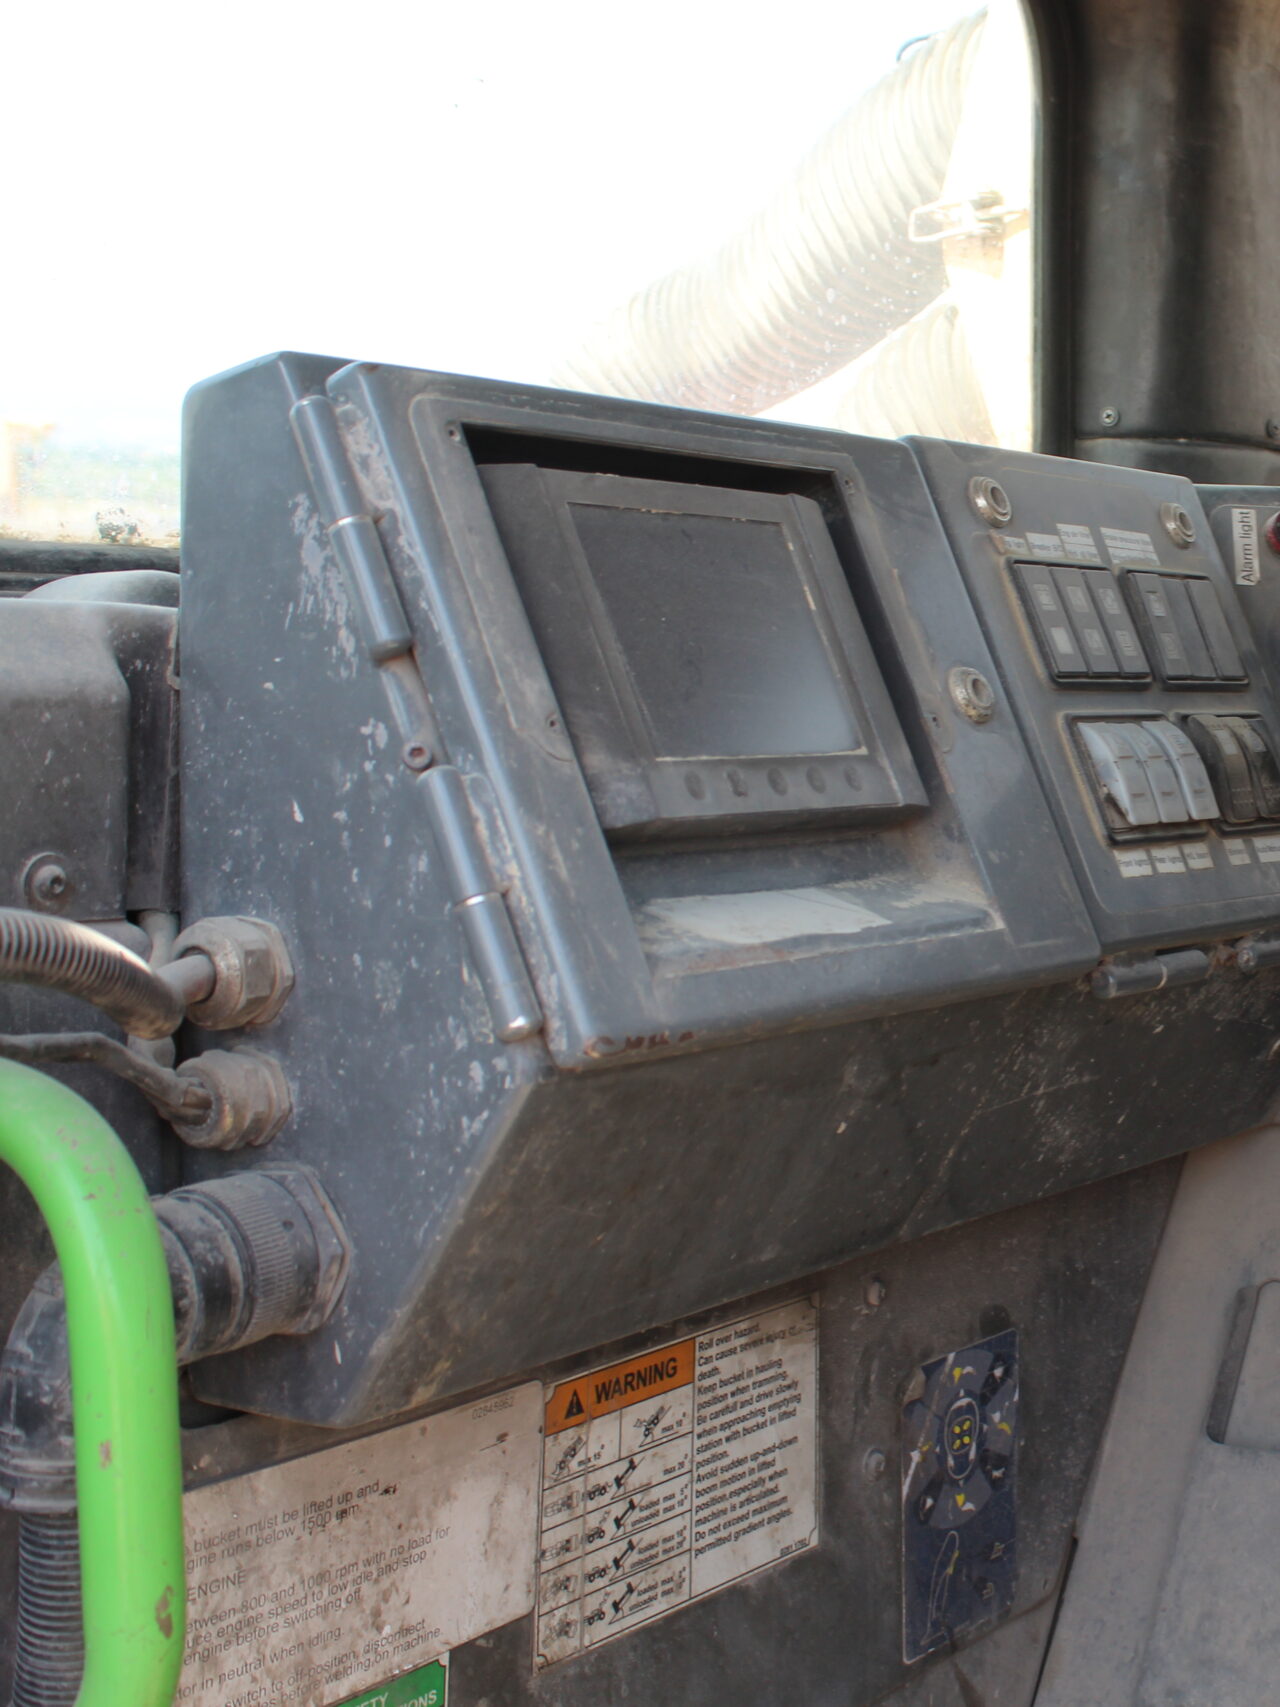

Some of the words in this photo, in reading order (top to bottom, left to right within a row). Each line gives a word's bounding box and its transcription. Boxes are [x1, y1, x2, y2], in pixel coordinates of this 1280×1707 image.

[1240, 511, 1251, 538] light
[1241, 541, 1255, 583] Alarm
[698, 1338, 714, 1353] Roll
[715, 1334, 732, 1347] over
[698, 1355, 714, 1367] Can
[715, 1346, 738, 1361] cause
[594, 1357, 678, 1404] WARNING
[696, 1392, 728, 1414] position
[730, 1384, 750, 1398] when
[697, 1382, 718, 1396] Keep
[718, 1370, 745, 1388] bucket
[746, 1369, 754, 1378] in
[755, 1358, 782, 1374] hauling
[696, 1414, 708, 1426] Be
[739, 1395, 754, 1409] and
[755, 1389, 774, 1403] drive
[776, 1380, 799, 1396] slowly
[696, 1426, 718, 1440] when
[719, 1407, 766, 1432] approaching
[768, 1392, 801, 1412] emptying
[696, 1438, 723, 1455] station
[724, 1430, 741, 1444] with
[742, 1418, 768, 1437] bucket
[770, 1416, 776, 1426] in
[778, 1406, 797, 1422] lifted
[696, 1466, 718, 1484] Avoid
[720, 1456, 748, 1474] sudden
[696, 1483, 718, 1498] boom
[720, 1472, 746, 1489] motion
[748, 1467, 756, 1476] in
[757, 1456, 776, 1472] lifted
[768, 1467, 788, 1482] when
[194, 1526, 241, 1552] bucket
[245, 1514, 278, 1535] must
[282, 1508, 299, 1524] be
[303, 1494, 333, 1517] lifted
[336, 1491, 352, 1507] up
[356, 1480, 380, 1499] and
[694, 1530, 706, 1542] Do
[708, 1522, 722, 1536] not
[722, 1510, 750, 1530] exceed
[752, 1496, 788, 1518] maximum
[695, 1506, 728, 1528] machine
[730, 1502, 736, 1512] is
[186, 1552, 216, 1574] gine
[221, 1540, 251, 1560] runs
[255, 1525, 296, 1548] below
[300, 1511, 332, 1532] 1500
[694, 1531, 732, 1559] permitted
[733, 1518, 765, 1542] gradient
[186, 1606, 236, 1634] etween
[240, 1593, 267, 1614] 800
[270, 1584, 295, 1602] and
[300, 1570, 332, 1591] 1000
[334, 1561, 358, 1580] rpm
[362, 1550, 386, 1568] with
[390, 1544, 404, 1557] no
[408, 1532, 432, 1551] load
[435, 1526, 450, 1540] for
[186, 1632, 212, 1650] uce
[216, 1612, 264, 1638] engine
[268, 1594, 308, 1626] speed
[311, 1590, 324, 1602] to
[328, 1578, 349, 1597] low
[352, 1570, 374, 1588] idle
[377, 1561, 399, 1578] and
[402, 1550, 427, 1569] stop
[183, 1638, 232, 1666] engine
[236, 1620, 280, 1647] before
[282, 1598, 342, 1630] switching
[346, 1586, 362, 1603] off
[177, 1683, 198, 1700] tor
[200, 1676, 214, 1691] in
[218, 1654, 266, 1684] neutral
[269, 1640, 304, 1664] when
[308, 1626, 346, 1649] idling.
[224, 1686, 267, 1707] switch
[270, 1680, 284, 1694] to
[362, 1618, 426, 1655] disconnect
[280, 1678, 321, 1700] before
[374, 1651, 390, 1664] on
